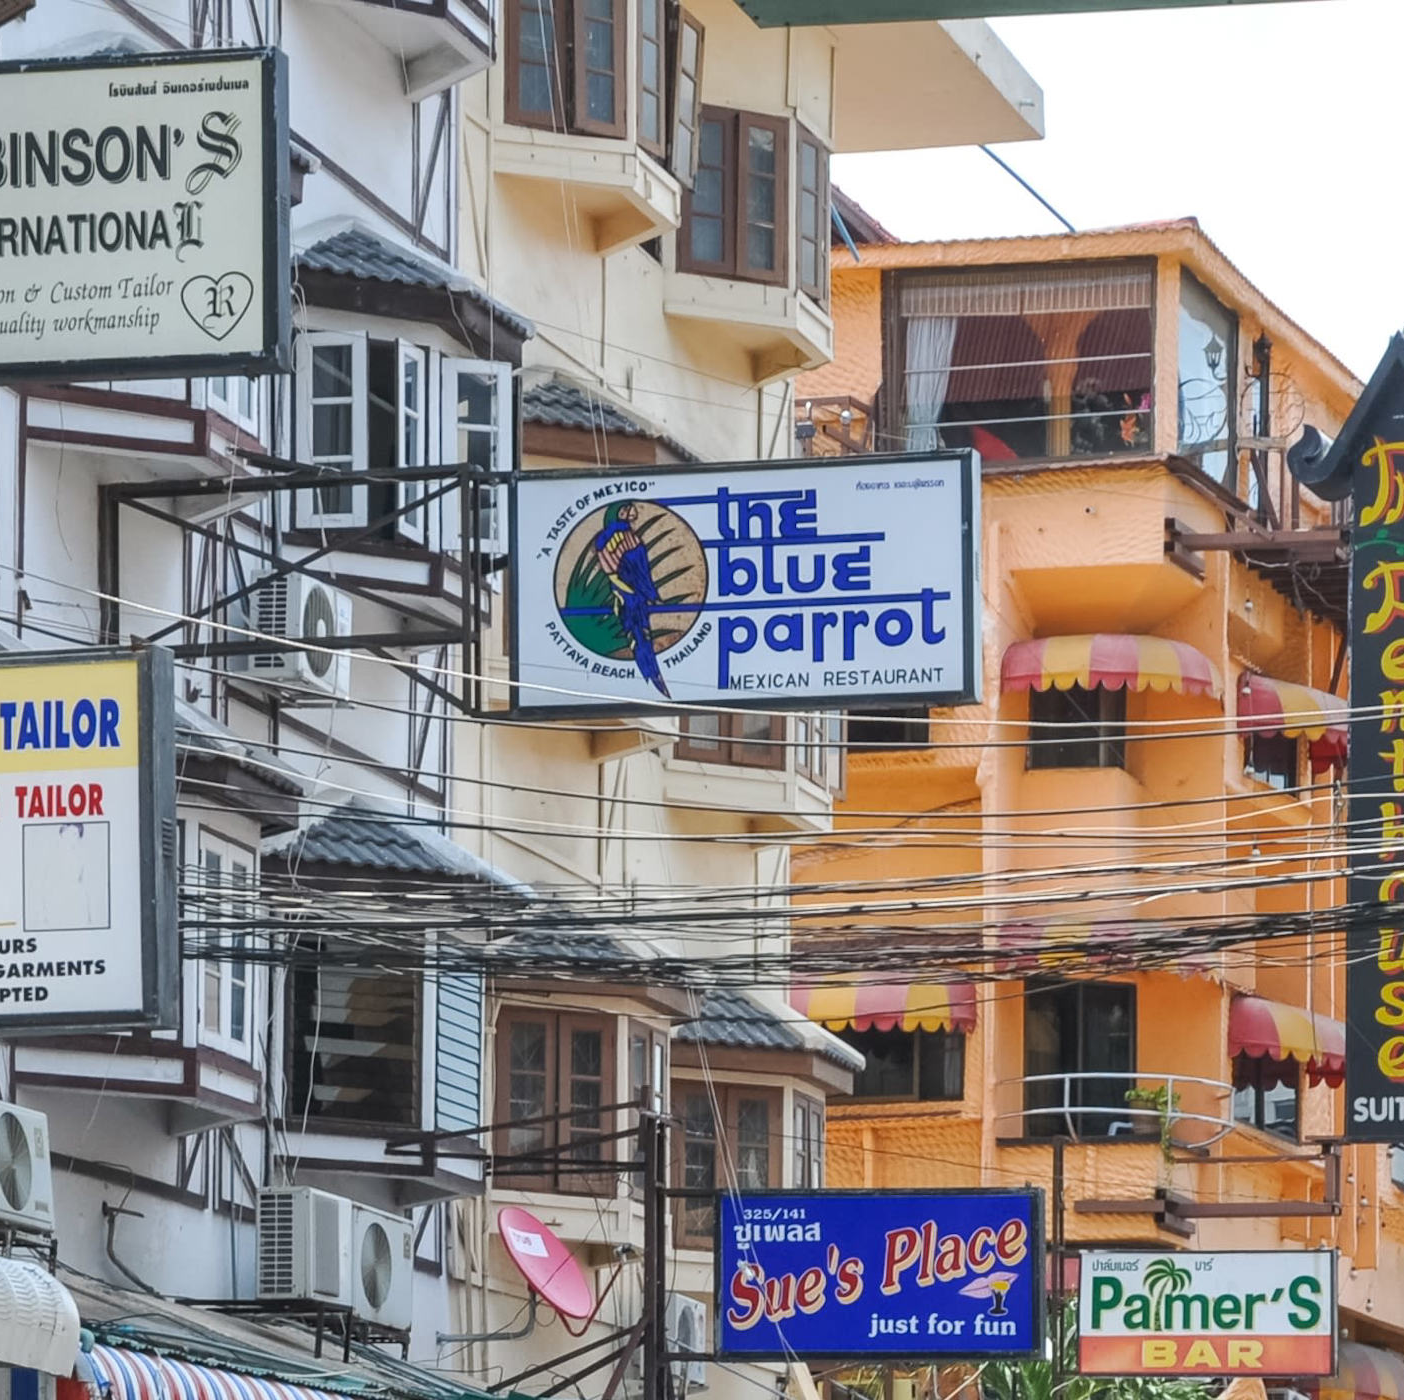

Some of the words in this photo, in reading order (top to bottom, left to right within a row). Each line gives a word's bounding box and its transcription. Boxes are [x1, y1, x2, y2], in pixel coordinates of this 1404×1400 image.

[24, 284, 42, 303] &
[51, 281, 112, 304] Custom
[118, 273, 174, 299] Tailor
[53, 305, 160, 335] workmanship
[546, 504, 577, 543] TASTE
[576, 493, 591, 511] OF
[718, 487, 817, 541] the
[718, 545, 871, 597] blue
[545, 621, 590, 670] PATTAYA
[591, 662, 635, 679] BEACH
[663, 621, 712, 669] THAILAND
[718, 588, 946, 689] parrot
[729, 672, 809, 691] MEXICAN
[822, 668, 943, 687] RESTAURANT
[0, 698, 121, 751] TAILOR
[15, 783, 104, 818] TAILOR
[743, 1208, 806, 1220] 325/141
[727, 1244, 863, 1330] Sue's
[881, 1218, 1027, 1297] Place
[869, 1313, 922, 1338] just
[928, 1313, 966, 1336] for
[974, 1314, 1017, 1336] fun
[1142, 1340, 1265, 1369] BAR
